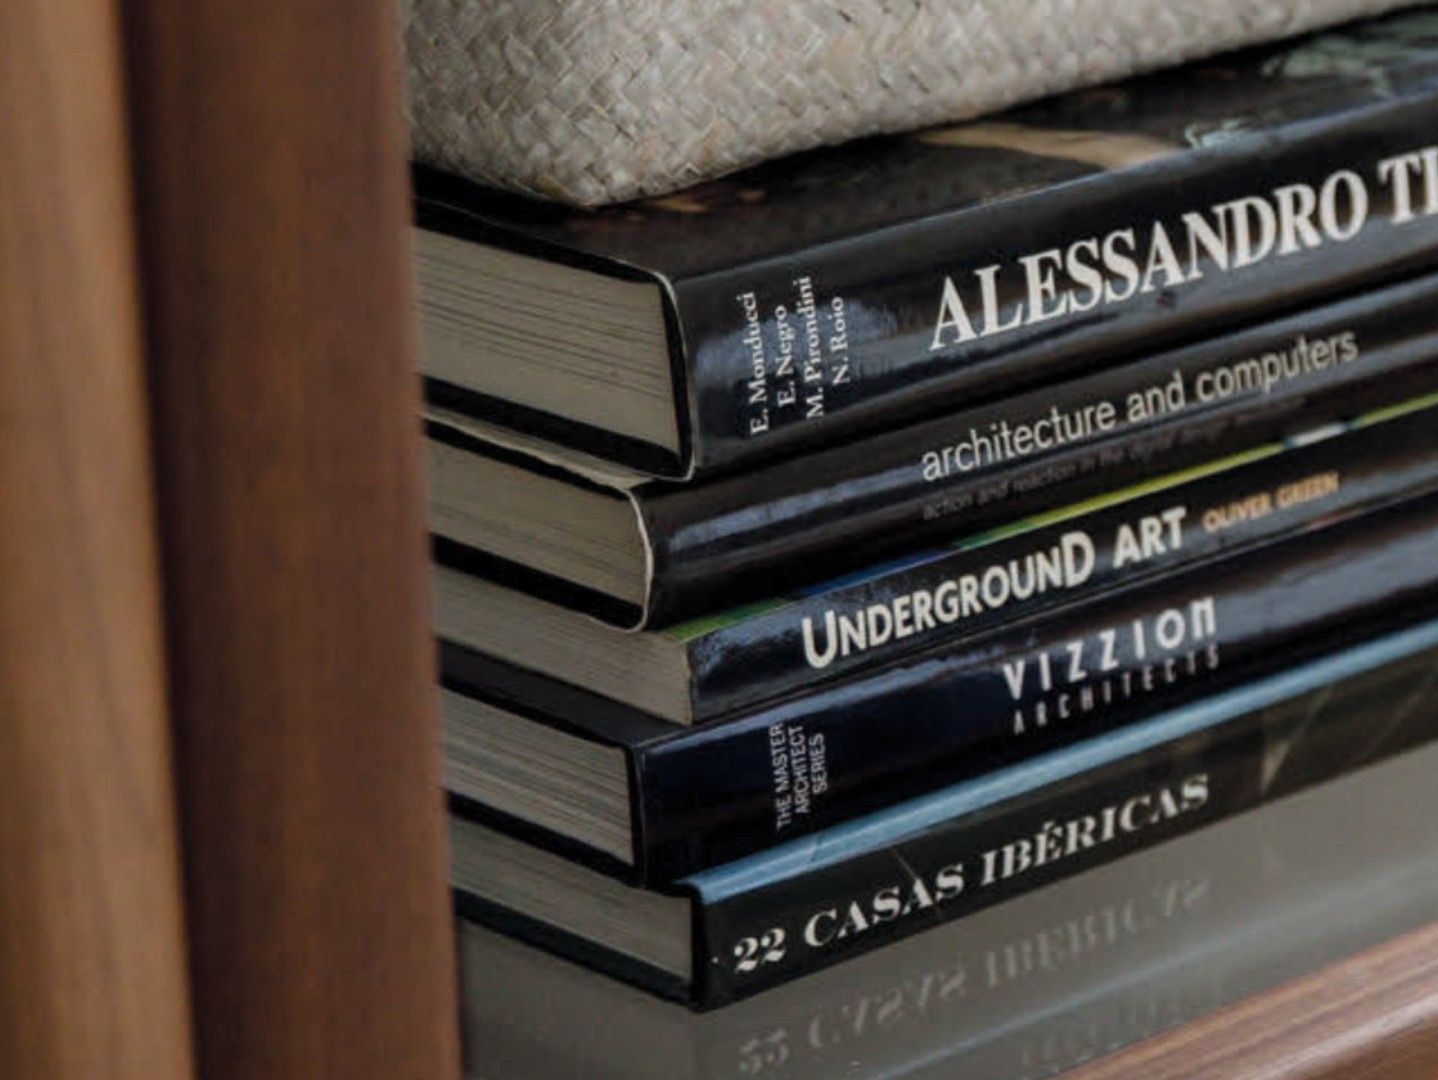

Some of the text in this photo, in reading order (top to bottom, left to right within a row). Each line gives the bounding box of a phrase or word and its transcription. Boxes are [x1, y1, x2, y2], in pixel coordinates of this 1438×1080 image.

[930, 169, 1368, 351] ALESSANDRO
[735, 292, 769, 433] E. Monducci
[775, 305, 796, 407] E. Negro
[793, 276, 824, 419] M. Pirondini
[827, 296, 850, 385] N. Roio
[921, 400, 1118, 481] architecture
[1127, 371, 1186, 424] and
[1196, 331, 1359, 394] computers
[1201, 472, 1339, 534] OLIVER GREEN
[802, 506, 1188, 670] UNDERGROUND ART
[1013, 644, 1219, 735] ARCHITECTS
[768, 722, 792, 831] THE MASTER
[788, 725, 810, 814] ARCHITECT
[808, 732, 828, 795] SERIES
[733, 773, 1210, 973] 22 CASAS IBÉRICAS
